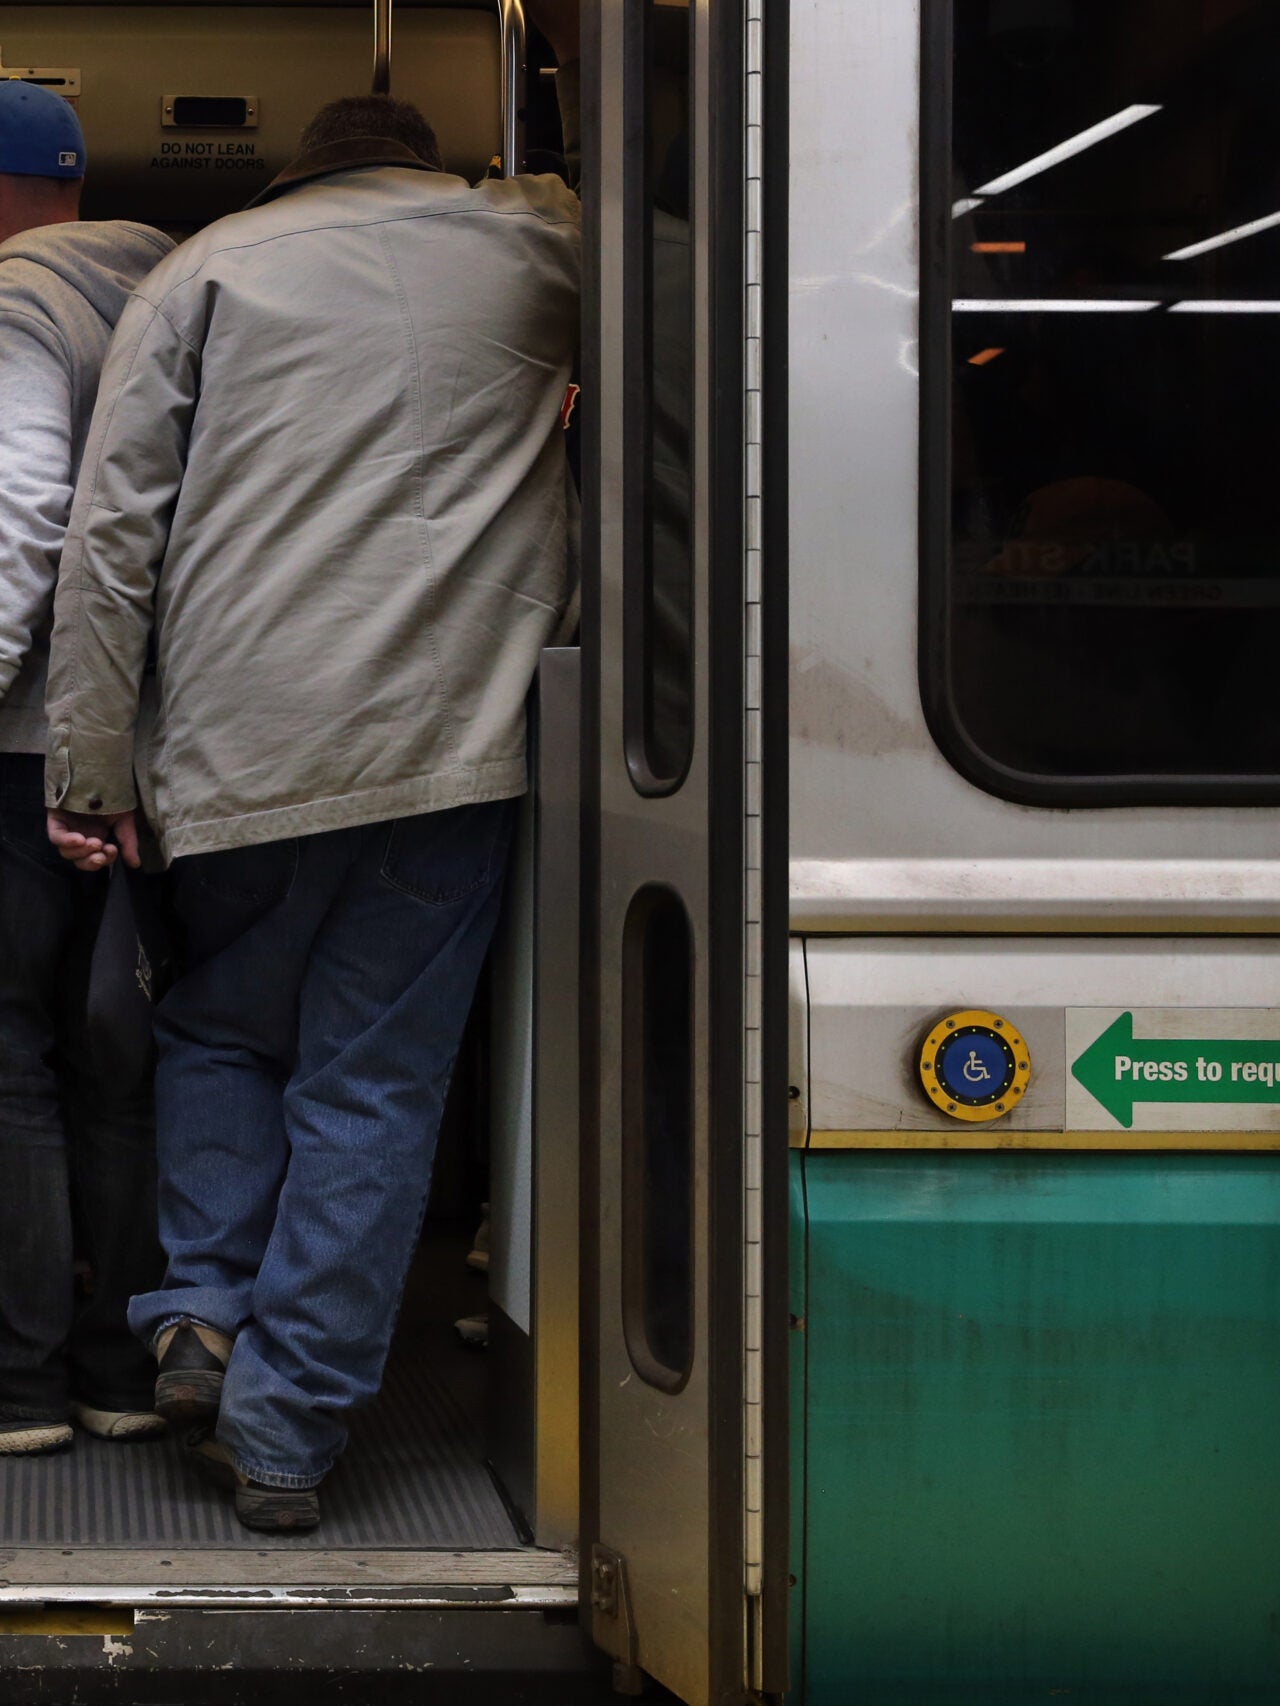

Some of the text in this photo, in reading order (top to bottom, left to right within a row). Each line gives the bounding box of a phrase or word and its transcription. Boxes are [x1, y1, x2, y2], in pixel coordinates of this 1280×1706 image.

[161, 142, 255, 155] DO NOT LEAN
[151, 158, 264, 170] AGAINST DOORS
[1114, 1055, 1188, 1081] Press
[1196, 1057, 1222, 1082] to
